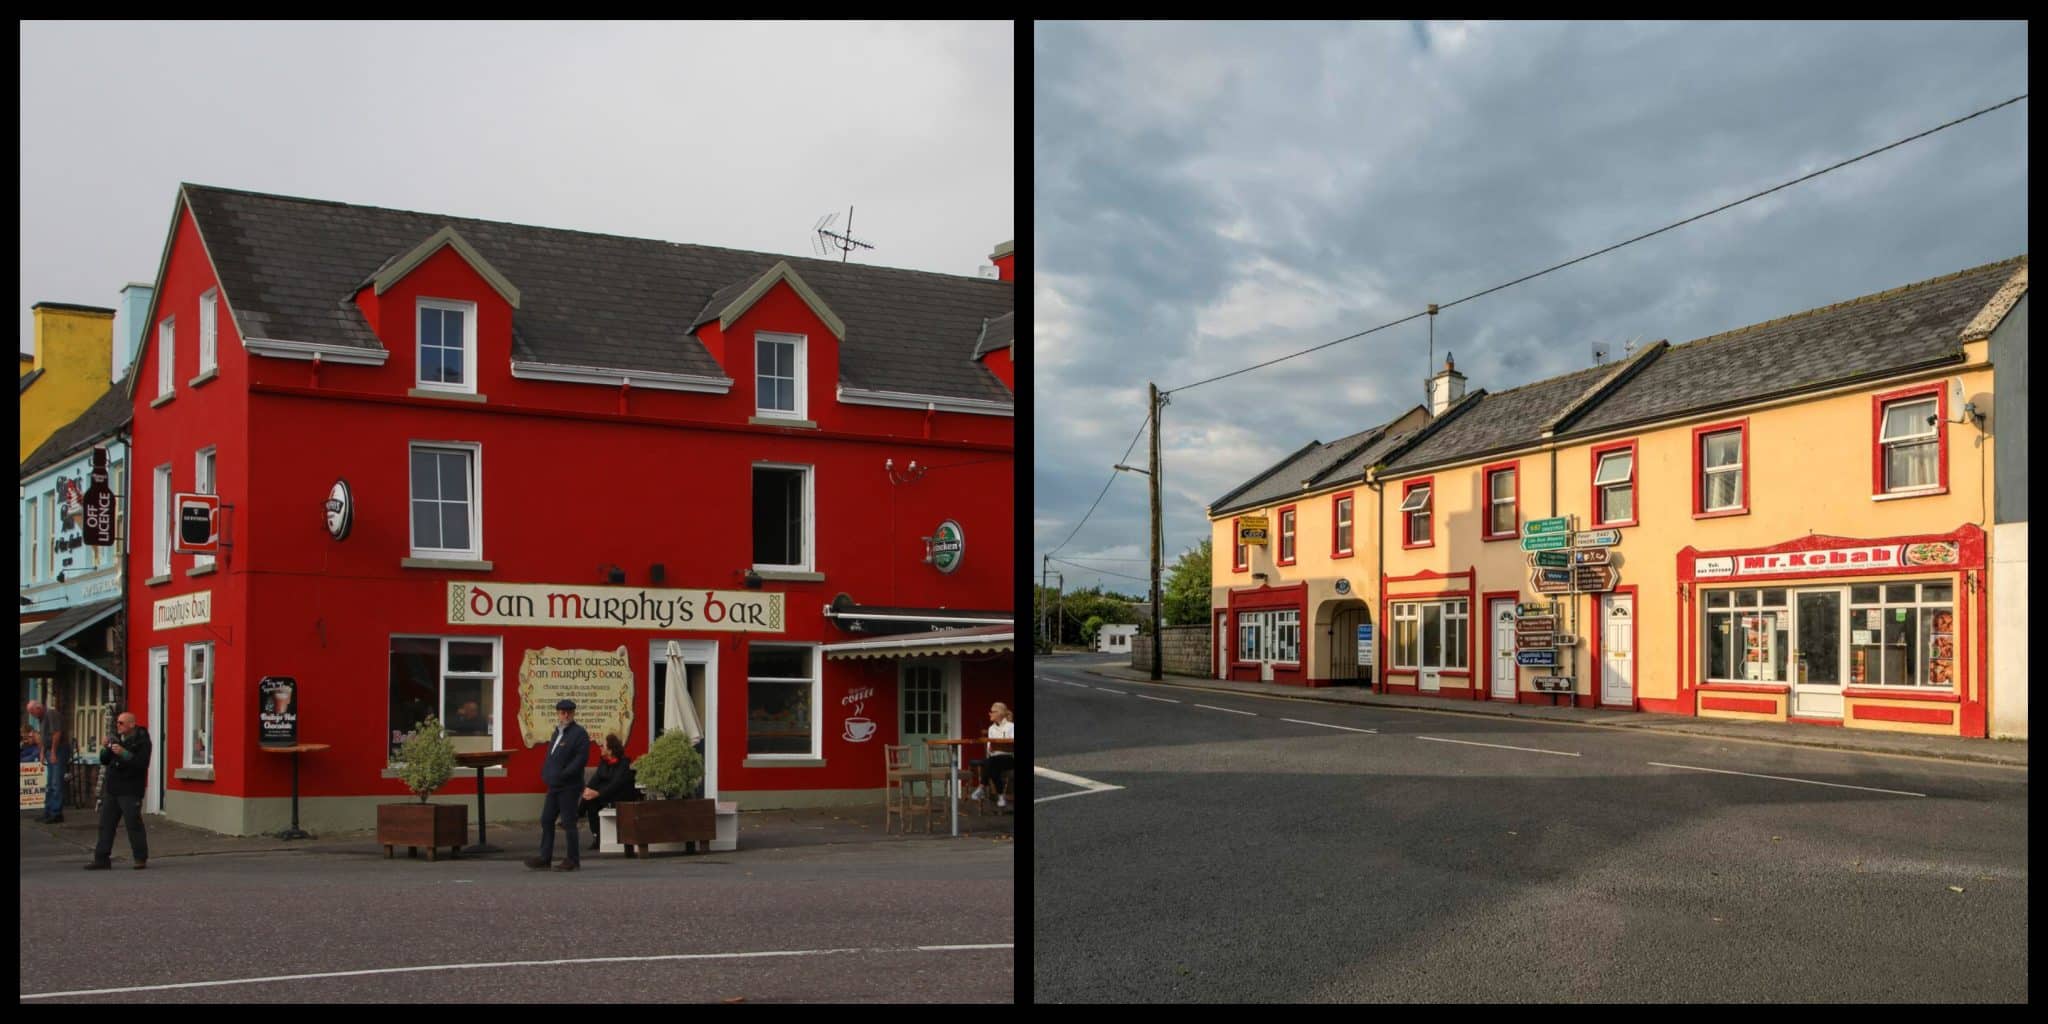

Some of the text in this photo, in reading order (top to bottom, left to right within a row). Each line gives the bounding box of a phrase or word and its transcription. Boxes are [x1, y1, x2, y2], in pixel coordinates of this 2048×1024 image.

[87, 504, 98, 528] OFF
[98, 492, 111, 542] LICENCE
[470, 586, 767, 628] Dan Murphy's Bar
[551, 656, 583, 667] stone
[584, 655, 626, 667] outside
[551, 669, 598, 682] Murphy's
